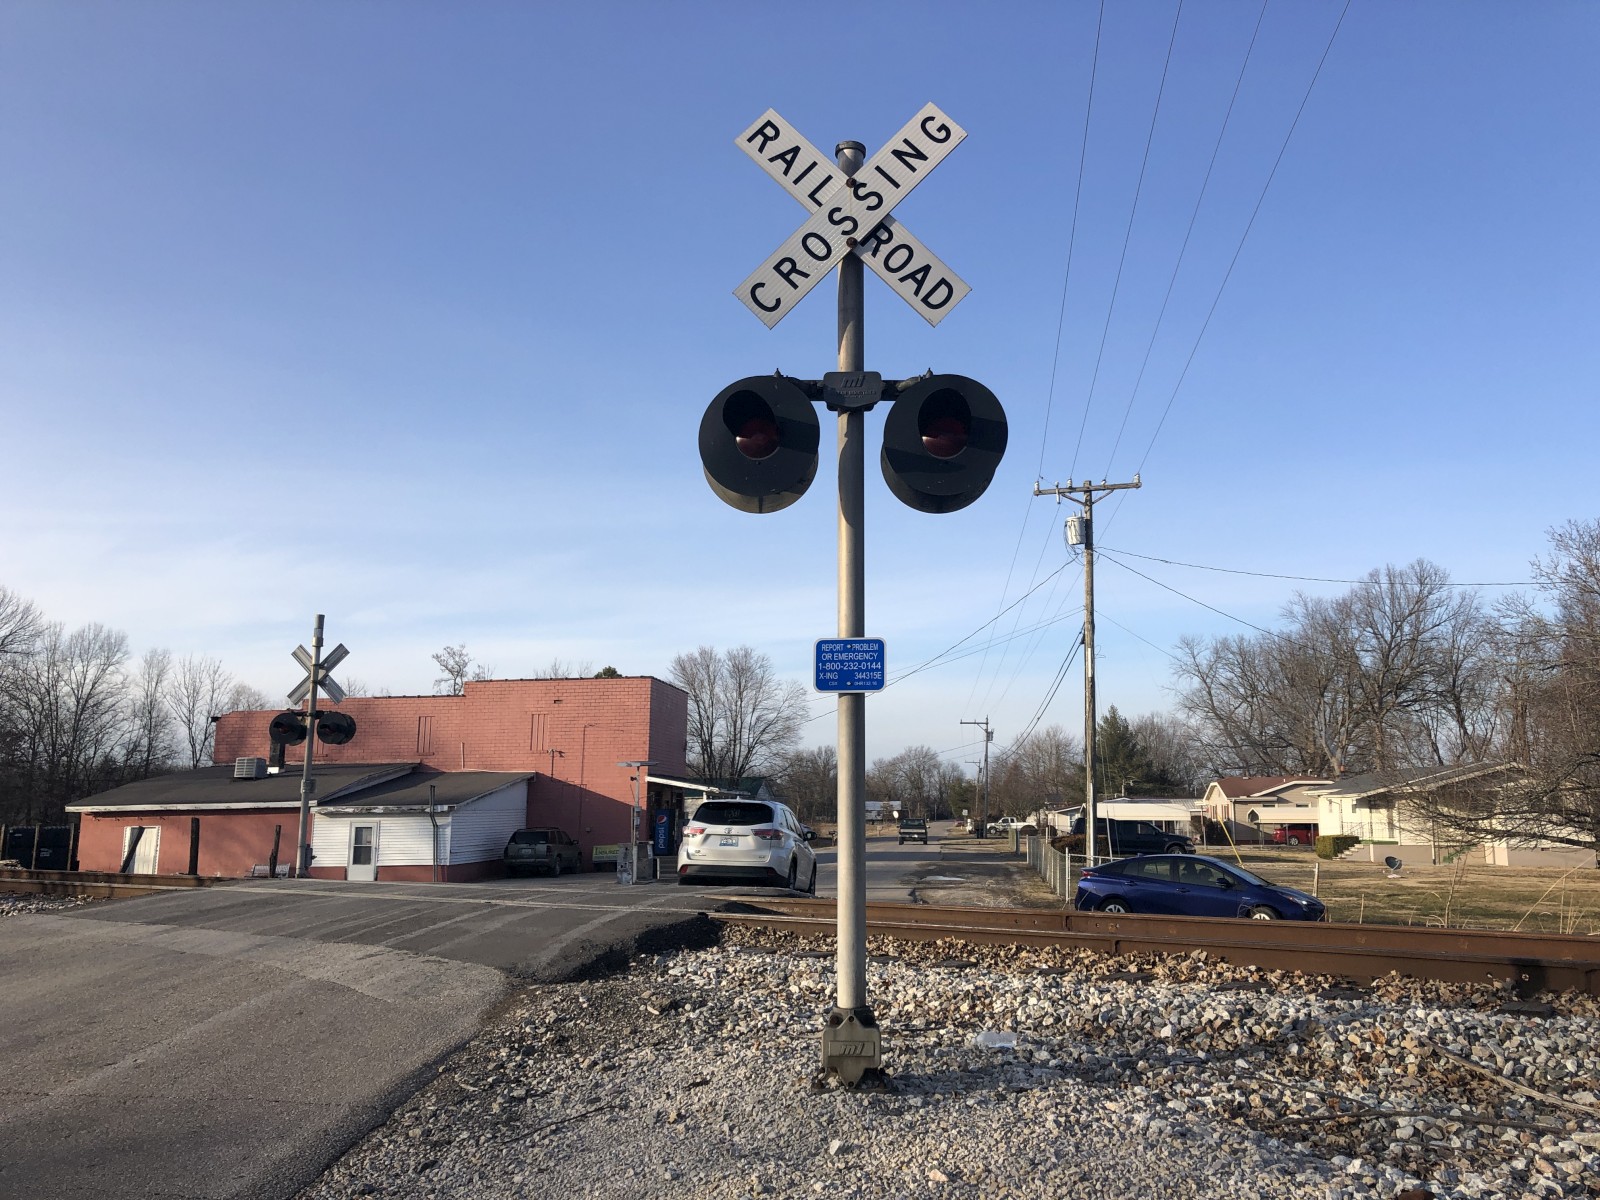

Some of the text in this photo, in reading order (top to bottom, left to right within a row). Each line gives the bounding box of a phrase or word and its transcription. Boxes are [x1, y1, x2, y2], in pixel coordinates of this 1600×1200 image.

[746, 119, 954, 310] RAIL ROAD
[749, 115, 952, 313] CROSSING
[821, 643, 879, 652] REPORT PROBLEM
[821, 652, 878, 661] OR EMERGENCY
[818, 661, 882, 671] 1-800-232-0144
[818, 671, 882, 680] X-ING 344315E
